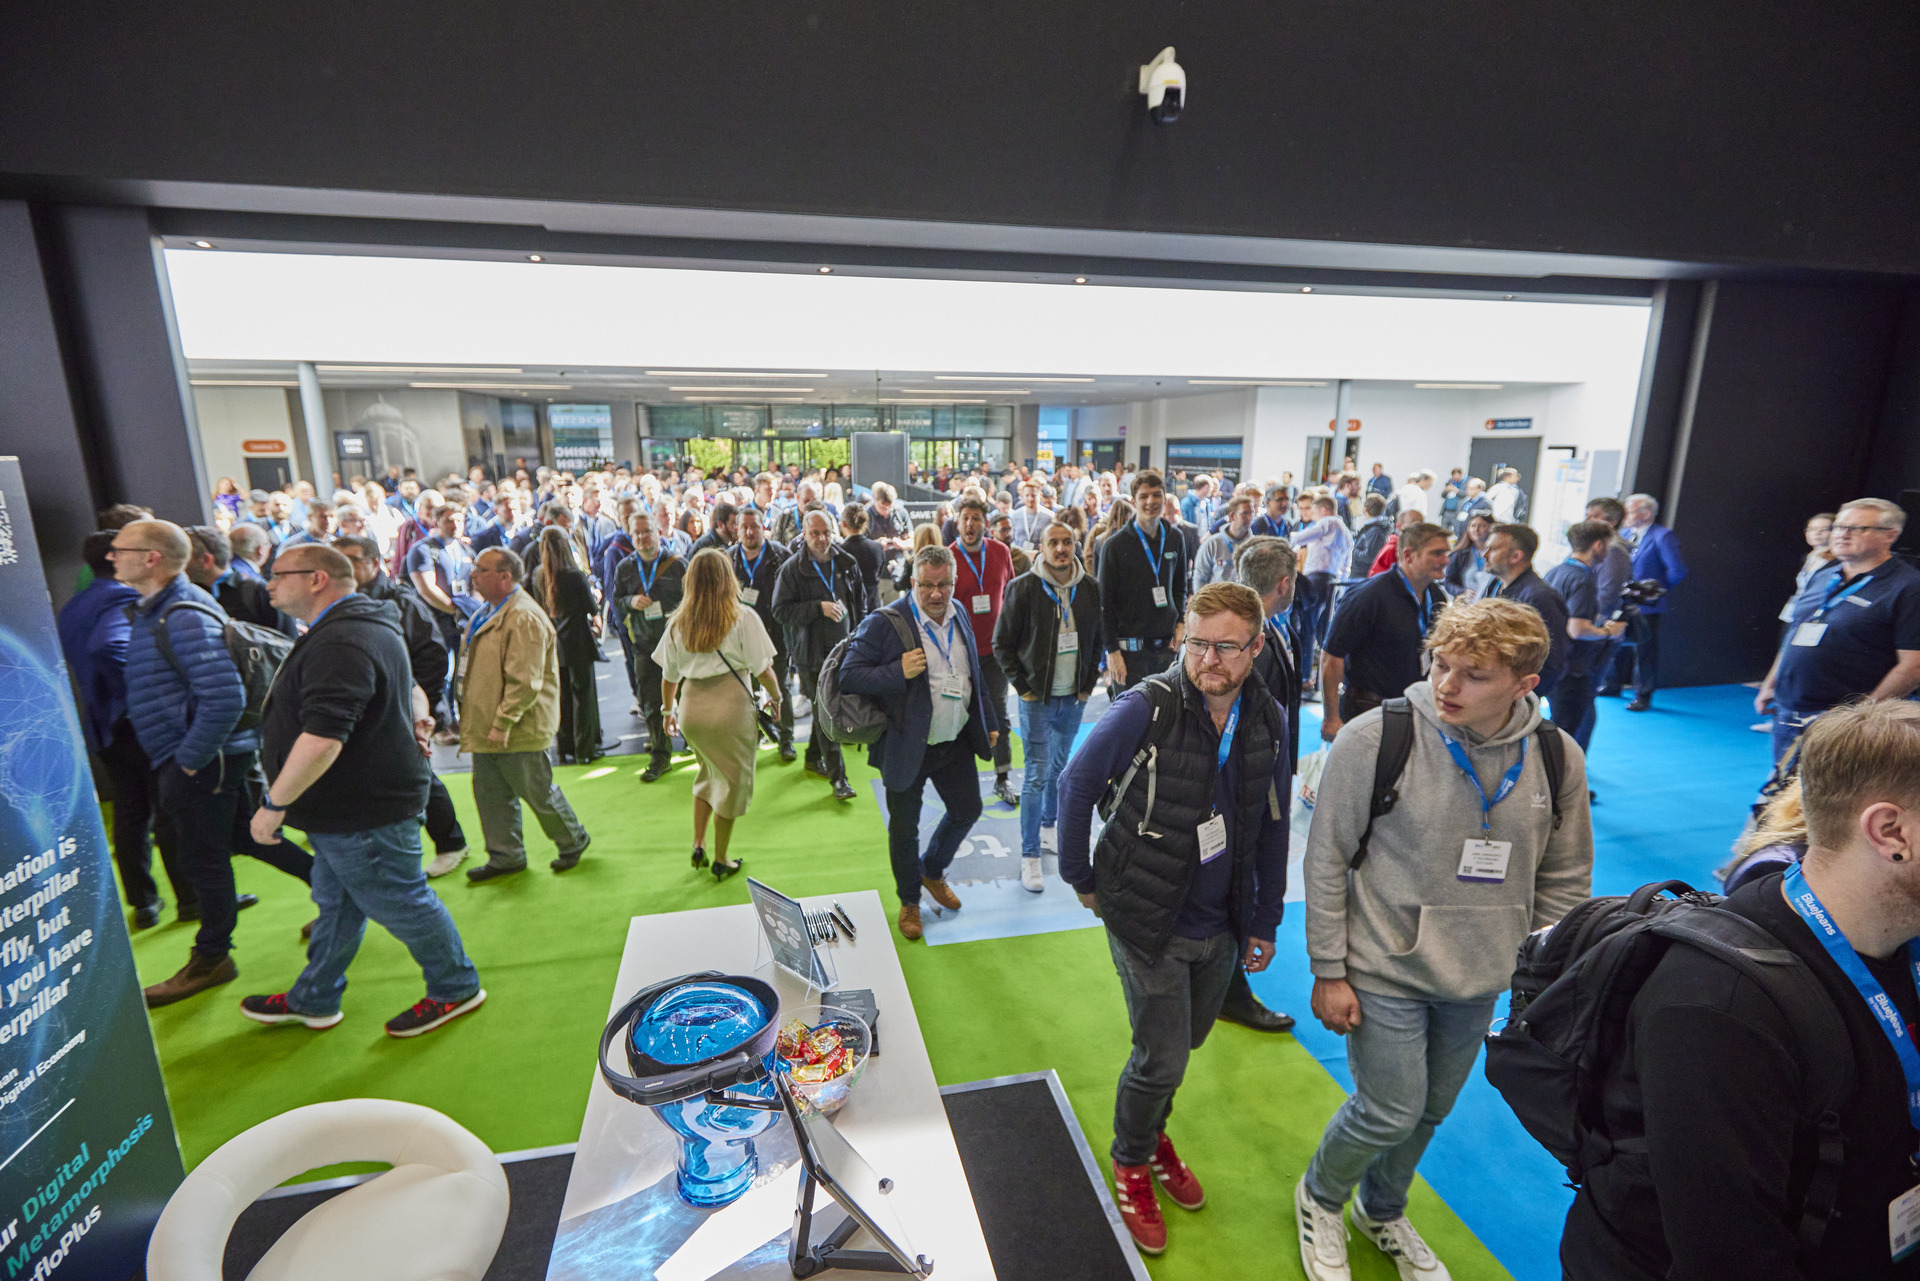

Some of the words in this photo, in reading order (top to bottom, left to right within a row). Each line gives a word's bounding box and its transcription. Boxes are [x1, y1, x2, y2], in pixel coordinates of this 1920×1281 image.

[0, 855, 56, 895] ation
[58, 835, 77, 860] is
[0, 867, 80, 933] terpillar
[1801, 892, 1836, 936] BlueJeans
[0, 934, 34, 967] fly,
[37, 905, 71, 944] but
[7, 960, 46, 1008] you
[48, 928, 93, 972] have
[1875, 993, 1903, 1038] BlueJeans
[0, 1068, 19, 1089] an
[36, 1029, 86, 1077] Economy
[6, 1113, 154, 1278] Metamorphosis
[22, 1141, 90, 1224] Digital
